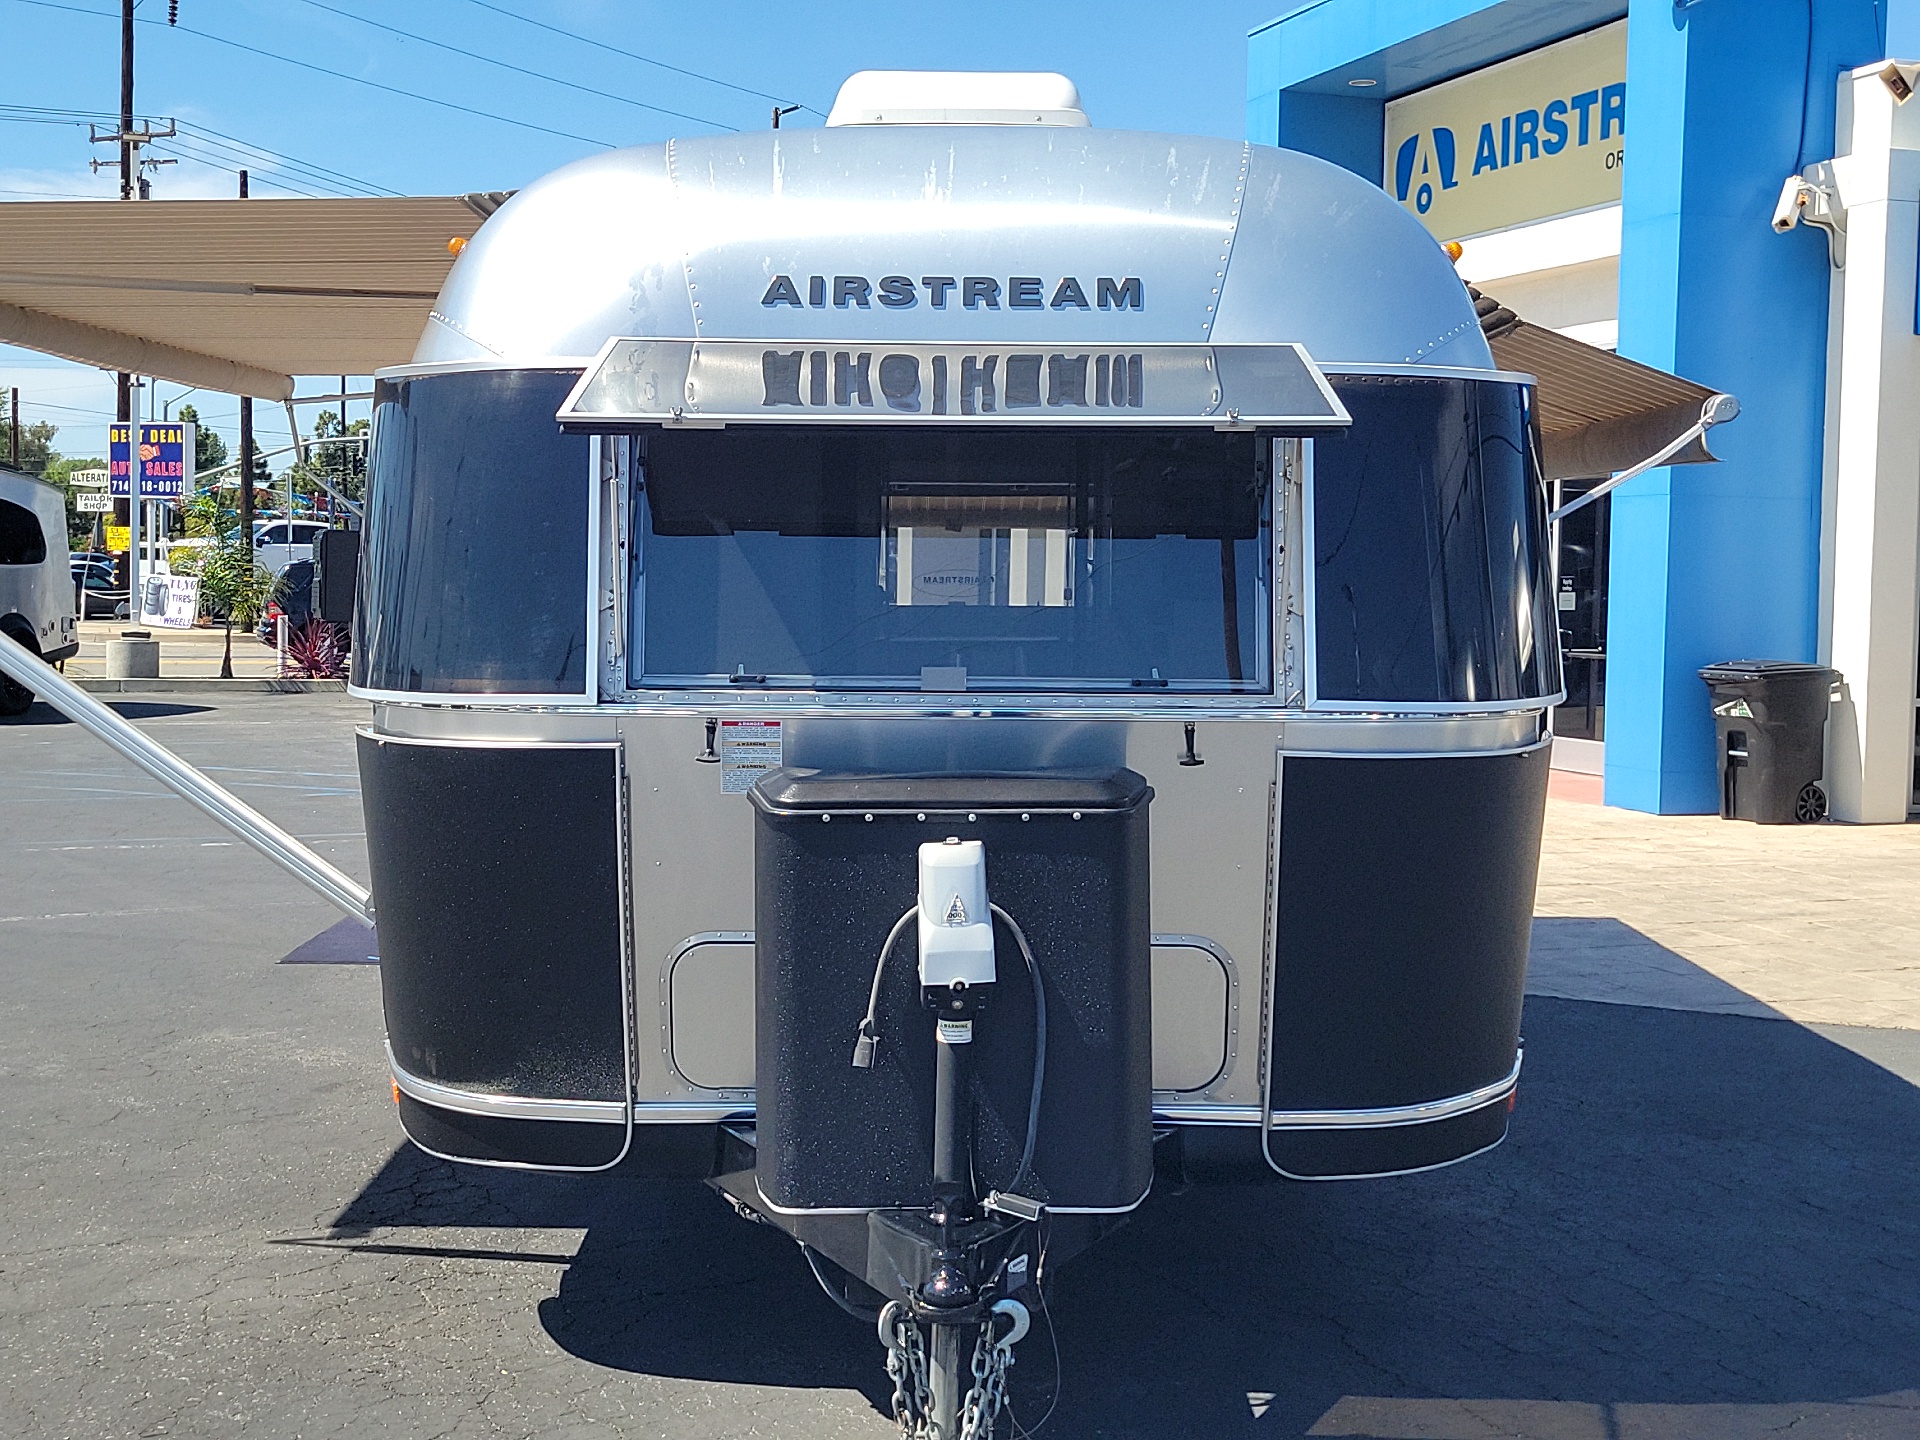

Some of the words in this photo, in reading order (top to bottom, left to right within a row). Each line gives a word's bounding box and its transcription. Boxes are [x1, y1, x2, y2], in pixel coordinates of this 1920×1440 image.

[761, 275, 1143, 311] AIRSTREAM
[150, 429, 183, 443] DEAL
[111, 461, 141, 475] AUT
[146, 461, 183, 476] SALES
[79, 494, 112, 502] TAILOR
[172, 594, 192, 604] TIRES
[163, 617, 191, 627] WHEELS
